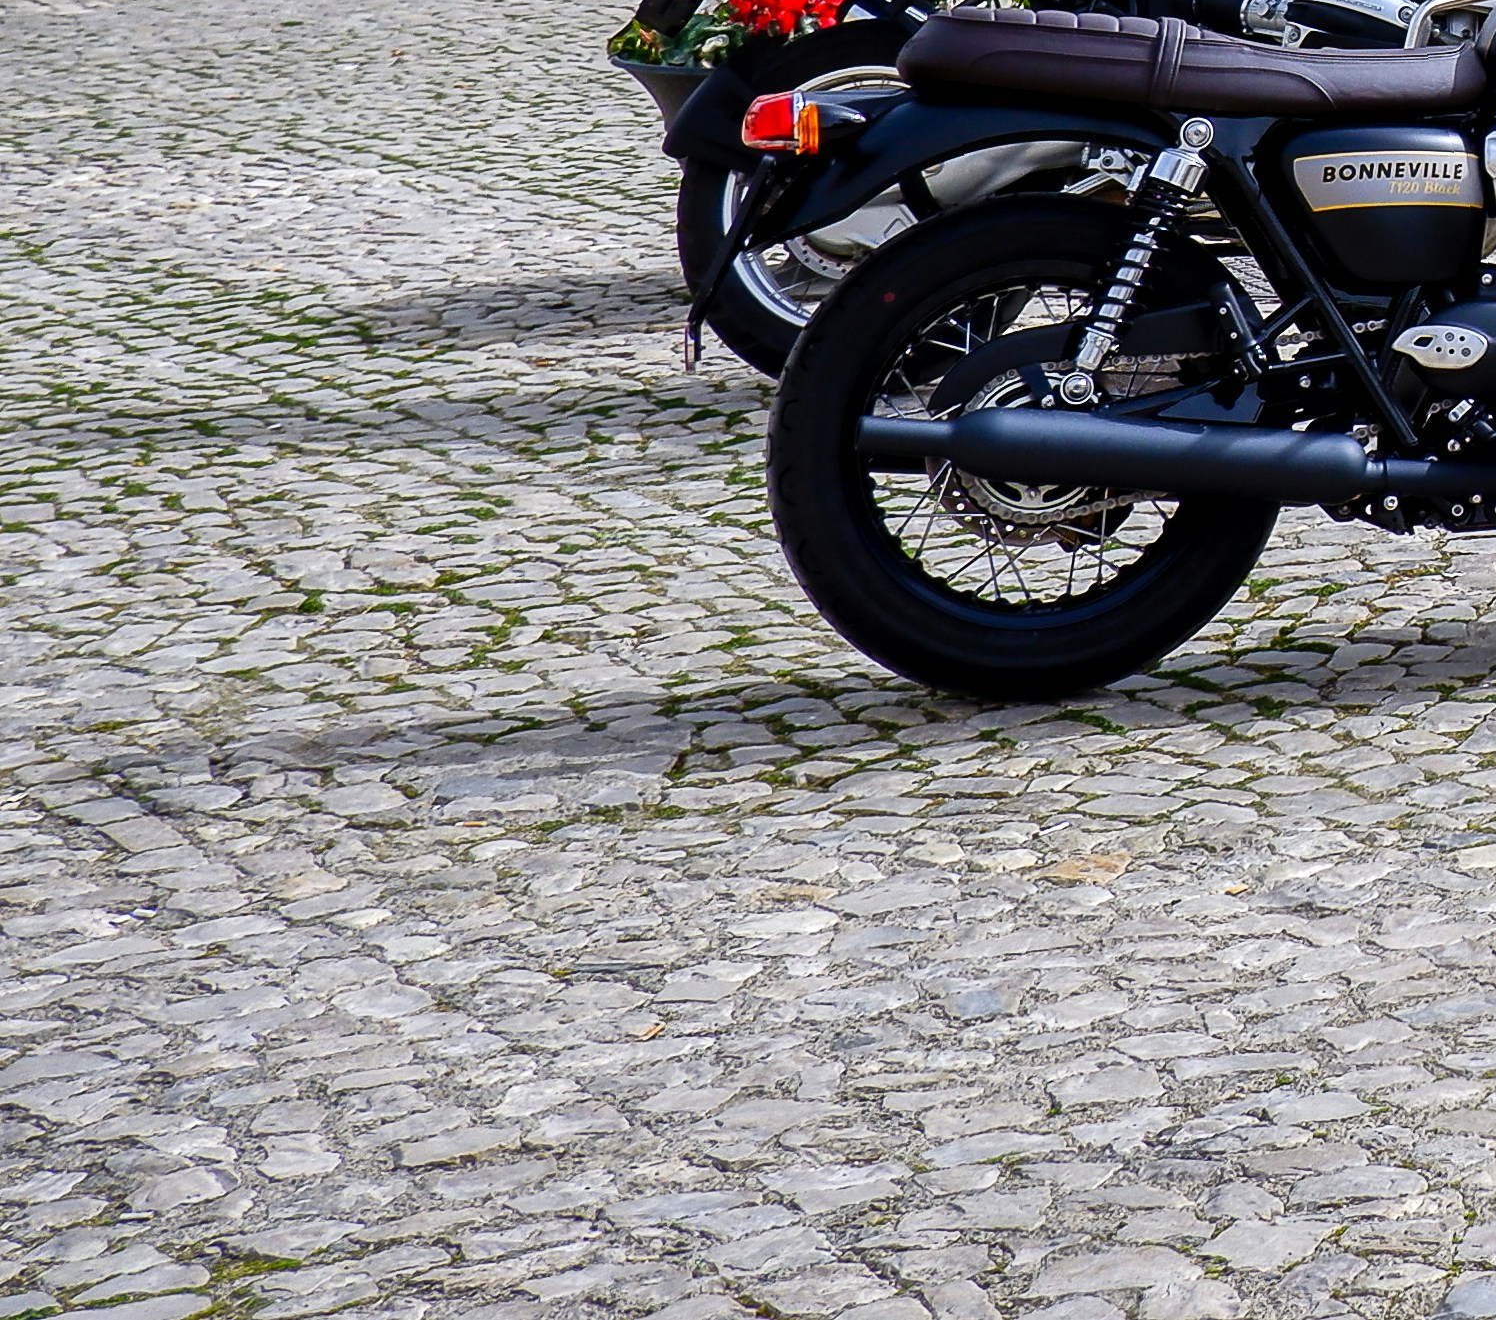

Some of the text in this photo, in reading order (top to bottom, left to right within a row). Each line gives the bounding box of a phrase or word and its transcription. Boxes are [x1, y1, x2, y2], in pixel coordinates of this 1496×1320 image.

[1322, 162, 1463, 183] BONNEVILLE
[1389, 180, 1461, 195] T120 Black
